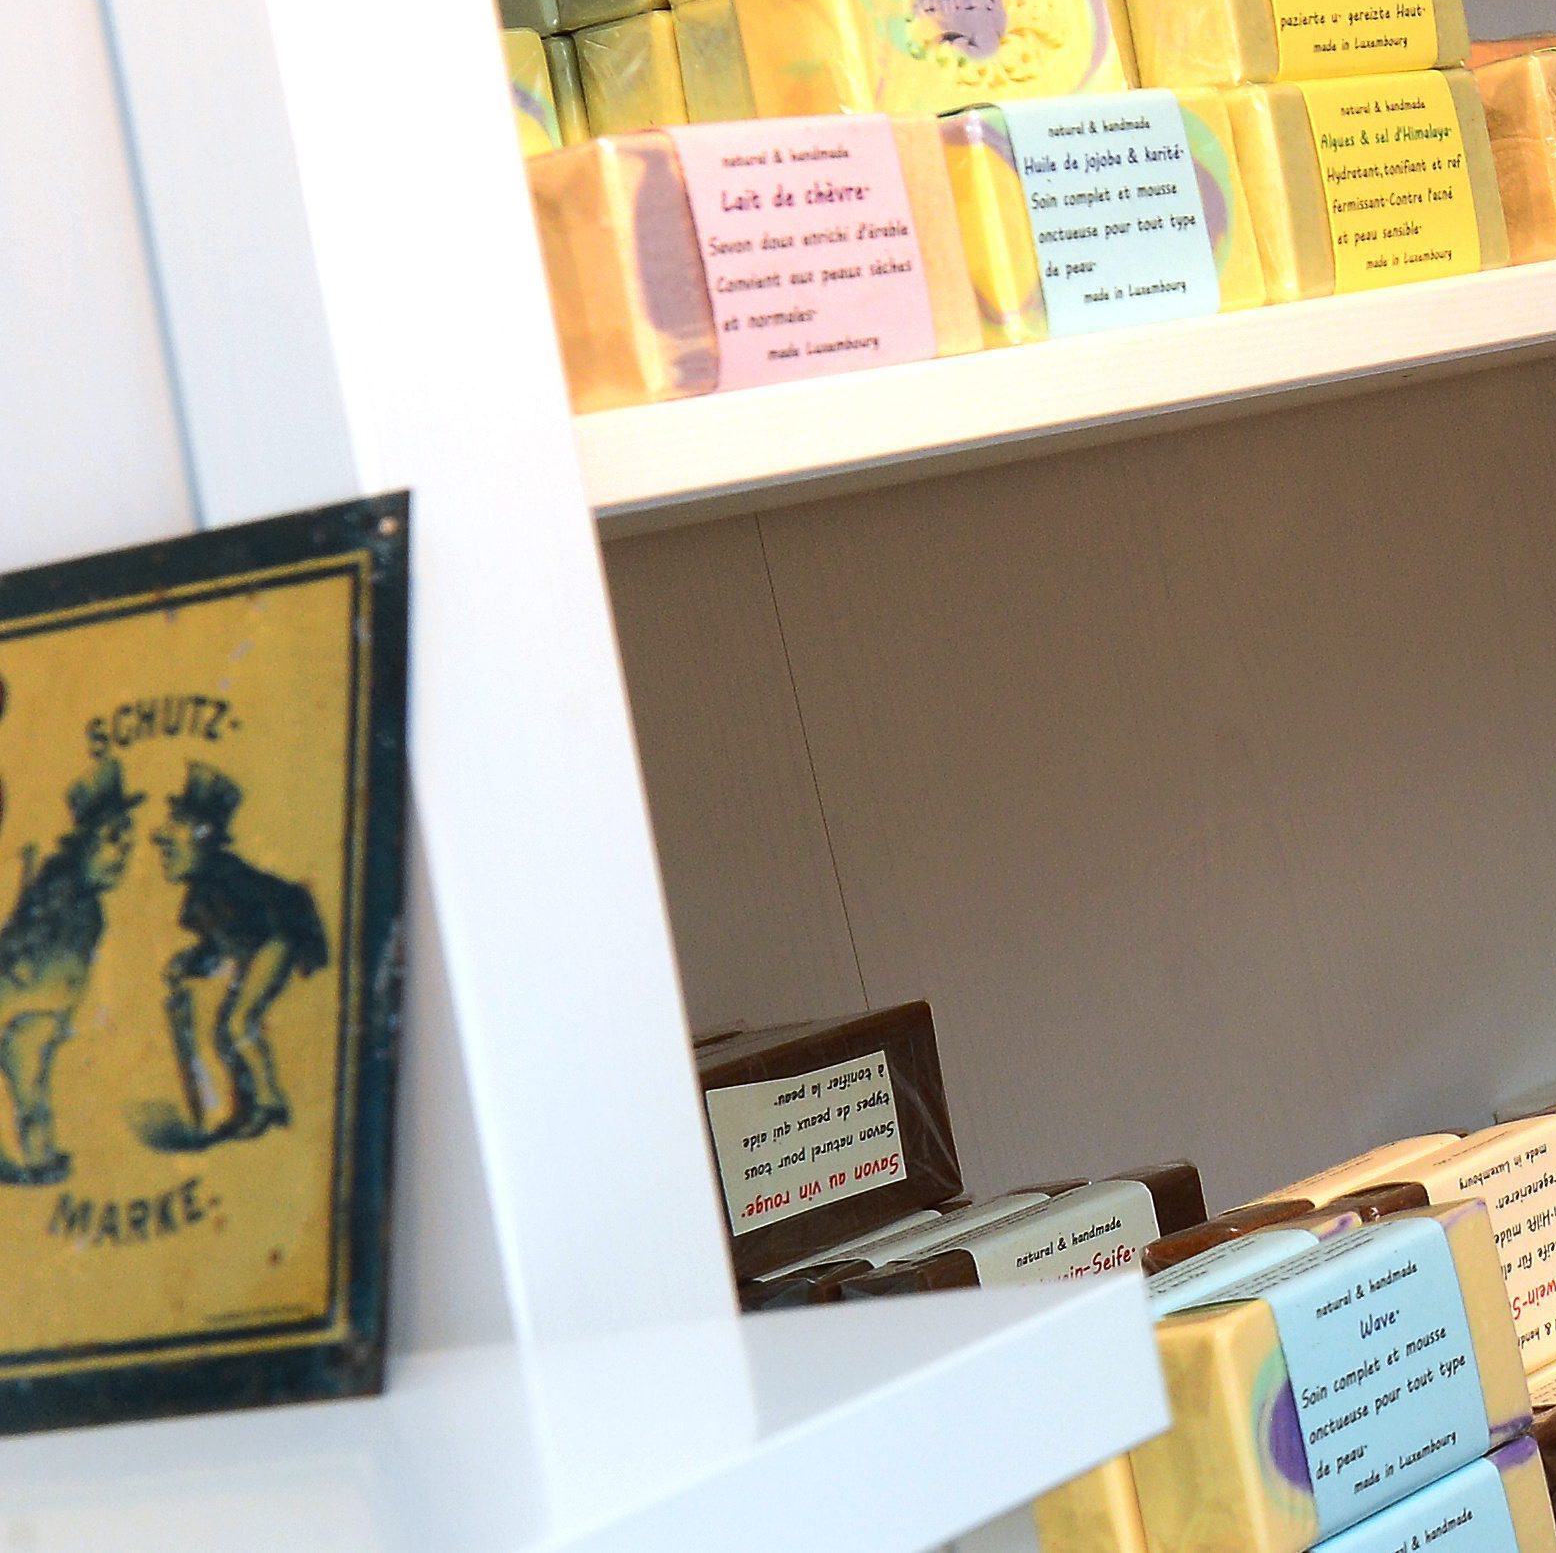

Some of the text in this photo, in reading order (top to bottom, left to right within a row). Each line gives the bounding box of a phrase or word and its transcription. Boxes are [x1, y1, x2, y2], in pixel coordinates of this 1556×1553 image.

[1023, 155, 1057, 175] Huile
[1063, 152, 1079, 170] de
[1084, 149, 1122, 173] jojoba
[1127, 147, 1139, 164] &
[827, 1067, 872, 1091] tonifier
[878, 1064, 885, 1078] à
[812, 1083, 821, 1098] la
[742, 1090, 890, 1152] types de peaux qui aide
[744, 1120, 894, 1181] Savon naturel pour tous
[829, 1172, 846, 1189] au
[854, 1153, 900, 1181] Savon
[800, 1180, 822, 1201] vin
[1016, 1216, 1122, 1267] natural & handmade
[1315, 1259, 1417, 1318] natural & handmade
[1301, 1327, 1446, 1409] Soin complet et mousse
[1309, 1354, 1466, 1444] onctueuse pour tout type
[1316, 1459, 1330, 1480] de
[1353, 1431, 1456, 1494] made in Luxembourg
